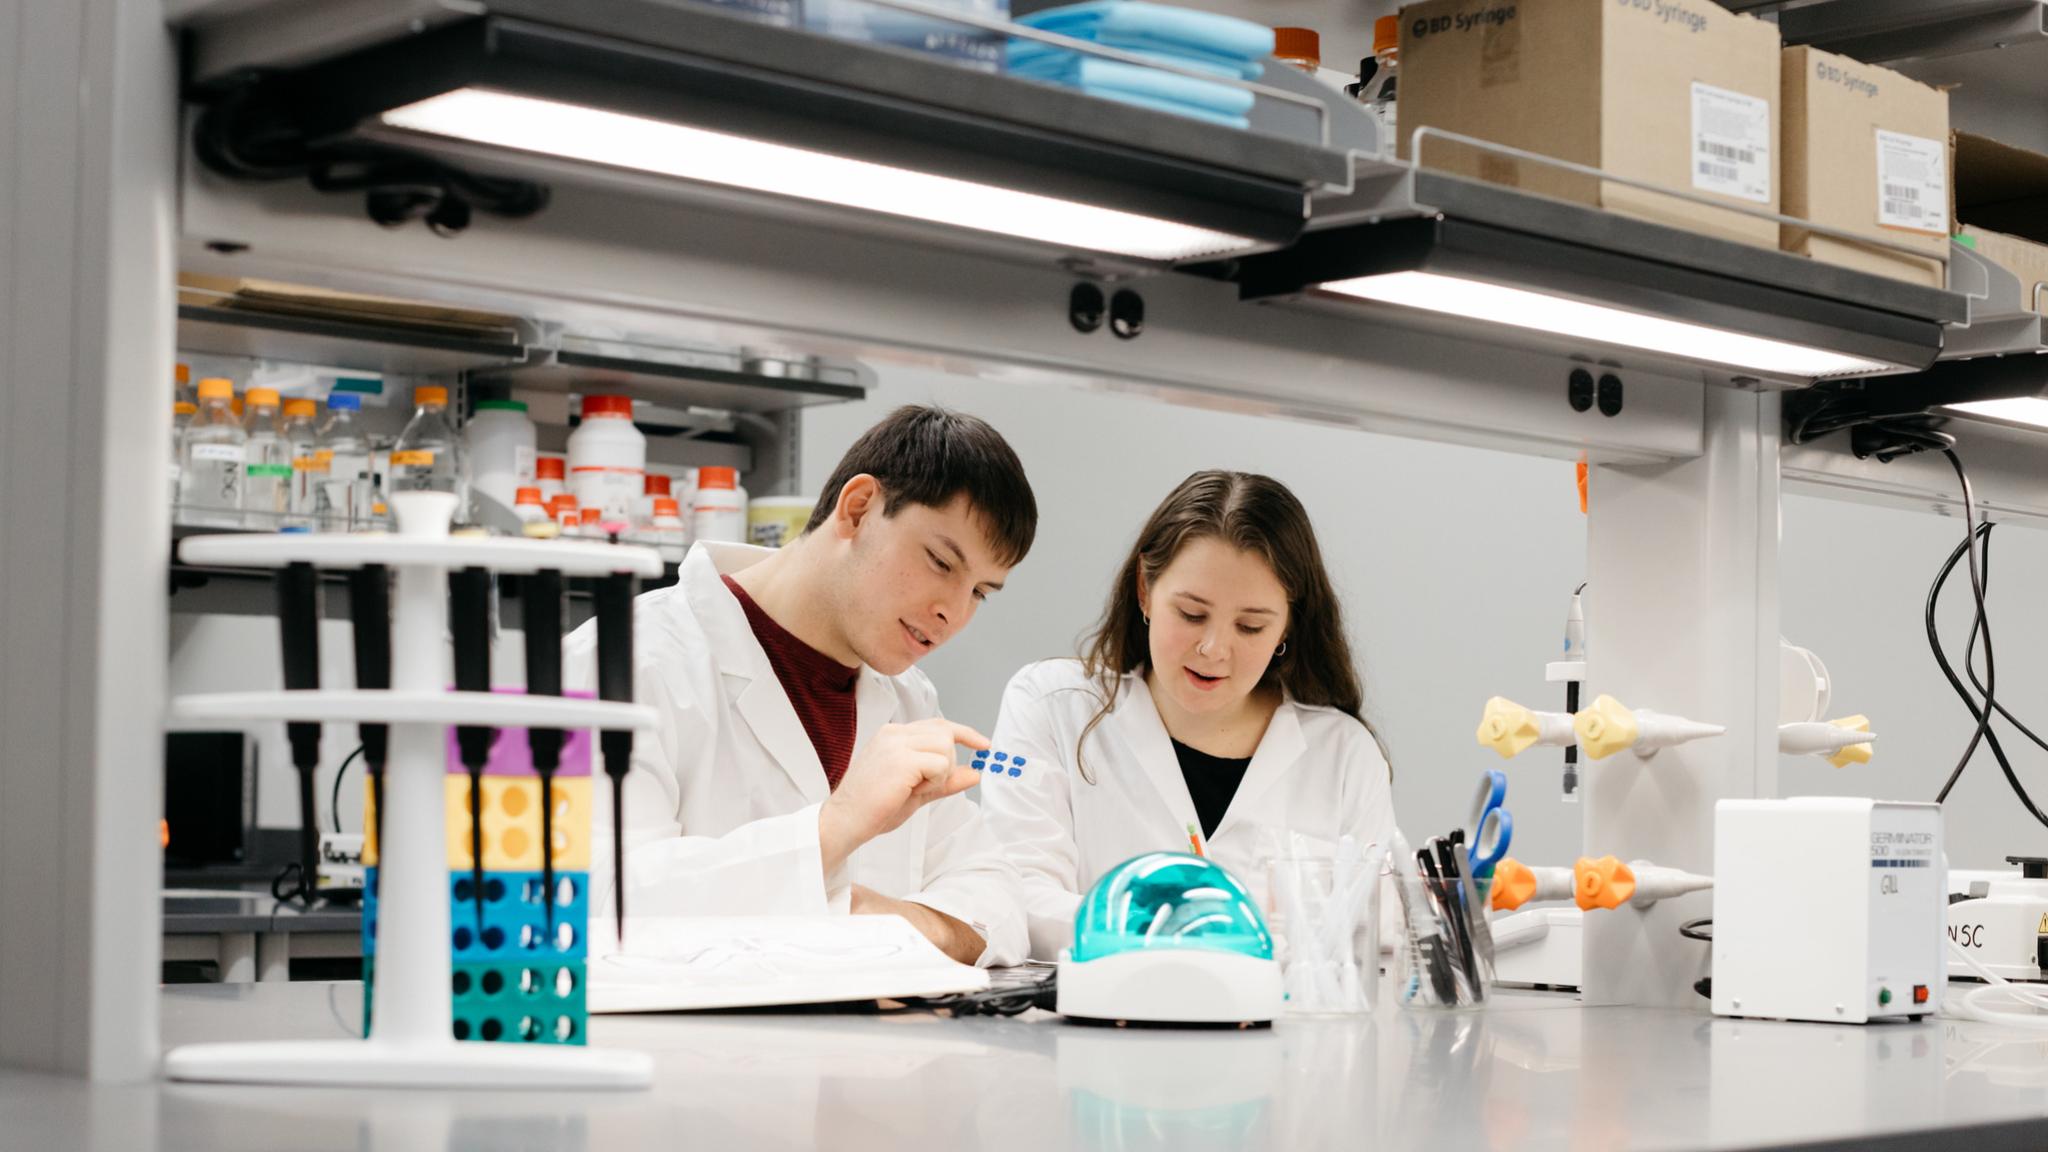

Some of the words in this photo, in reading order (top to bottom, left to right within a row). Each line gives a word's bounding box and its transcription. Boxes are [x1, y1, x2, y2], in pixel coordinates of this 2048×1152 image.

[1429, 15, 1452, 34] BD
[1456, 6, 1516, 33] Syringe
[1828, 66, 1841, 83] BD
[1843, 71, 1879, 98] Syringe
[1871, 832, 1933, 844] GERMINATOR
